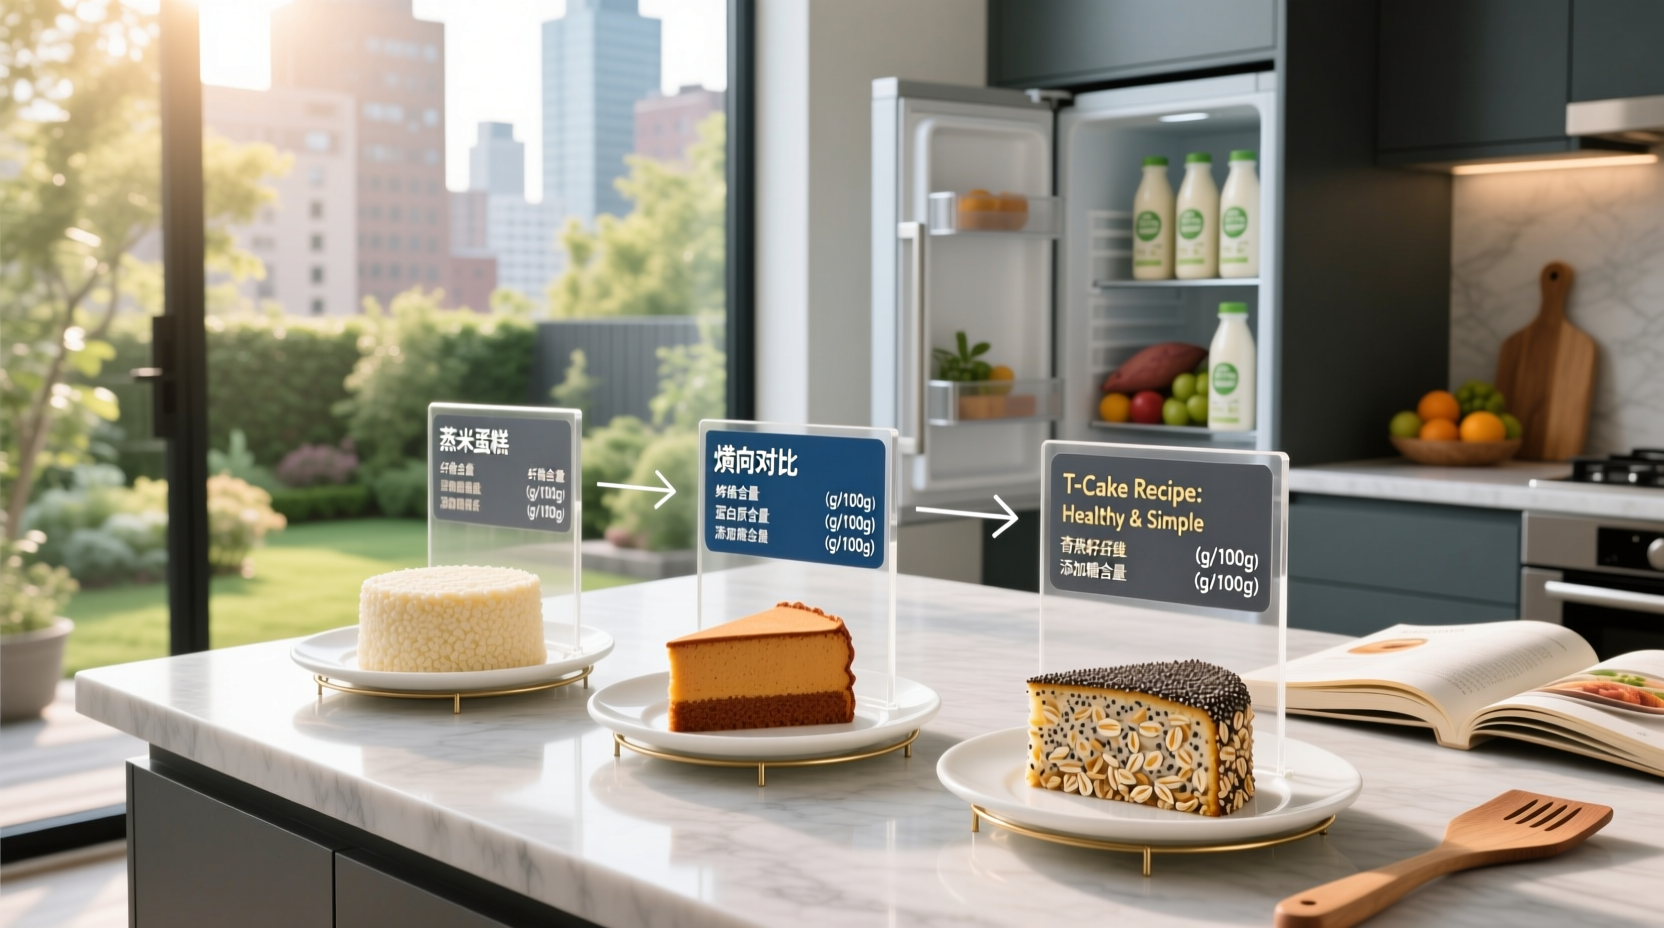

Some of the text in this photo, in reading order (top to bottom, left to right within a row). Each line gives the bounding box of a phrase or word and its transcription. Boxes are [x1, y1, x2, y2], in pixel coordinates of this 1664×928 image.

[825, 491, 876, 513] (g/100g)
[1062, 472, 1203, 507] T-Cake Recipe:
[825, 513, 876, 536] (g/100g)
[1062, 503, 1204, 536] Healthy & Simple
[824, 535, 875, 558] (g/100g)
[1195, 545, 1259, 573] (g/100g)
[1194, 571, 1259, 598] (g/100g)
